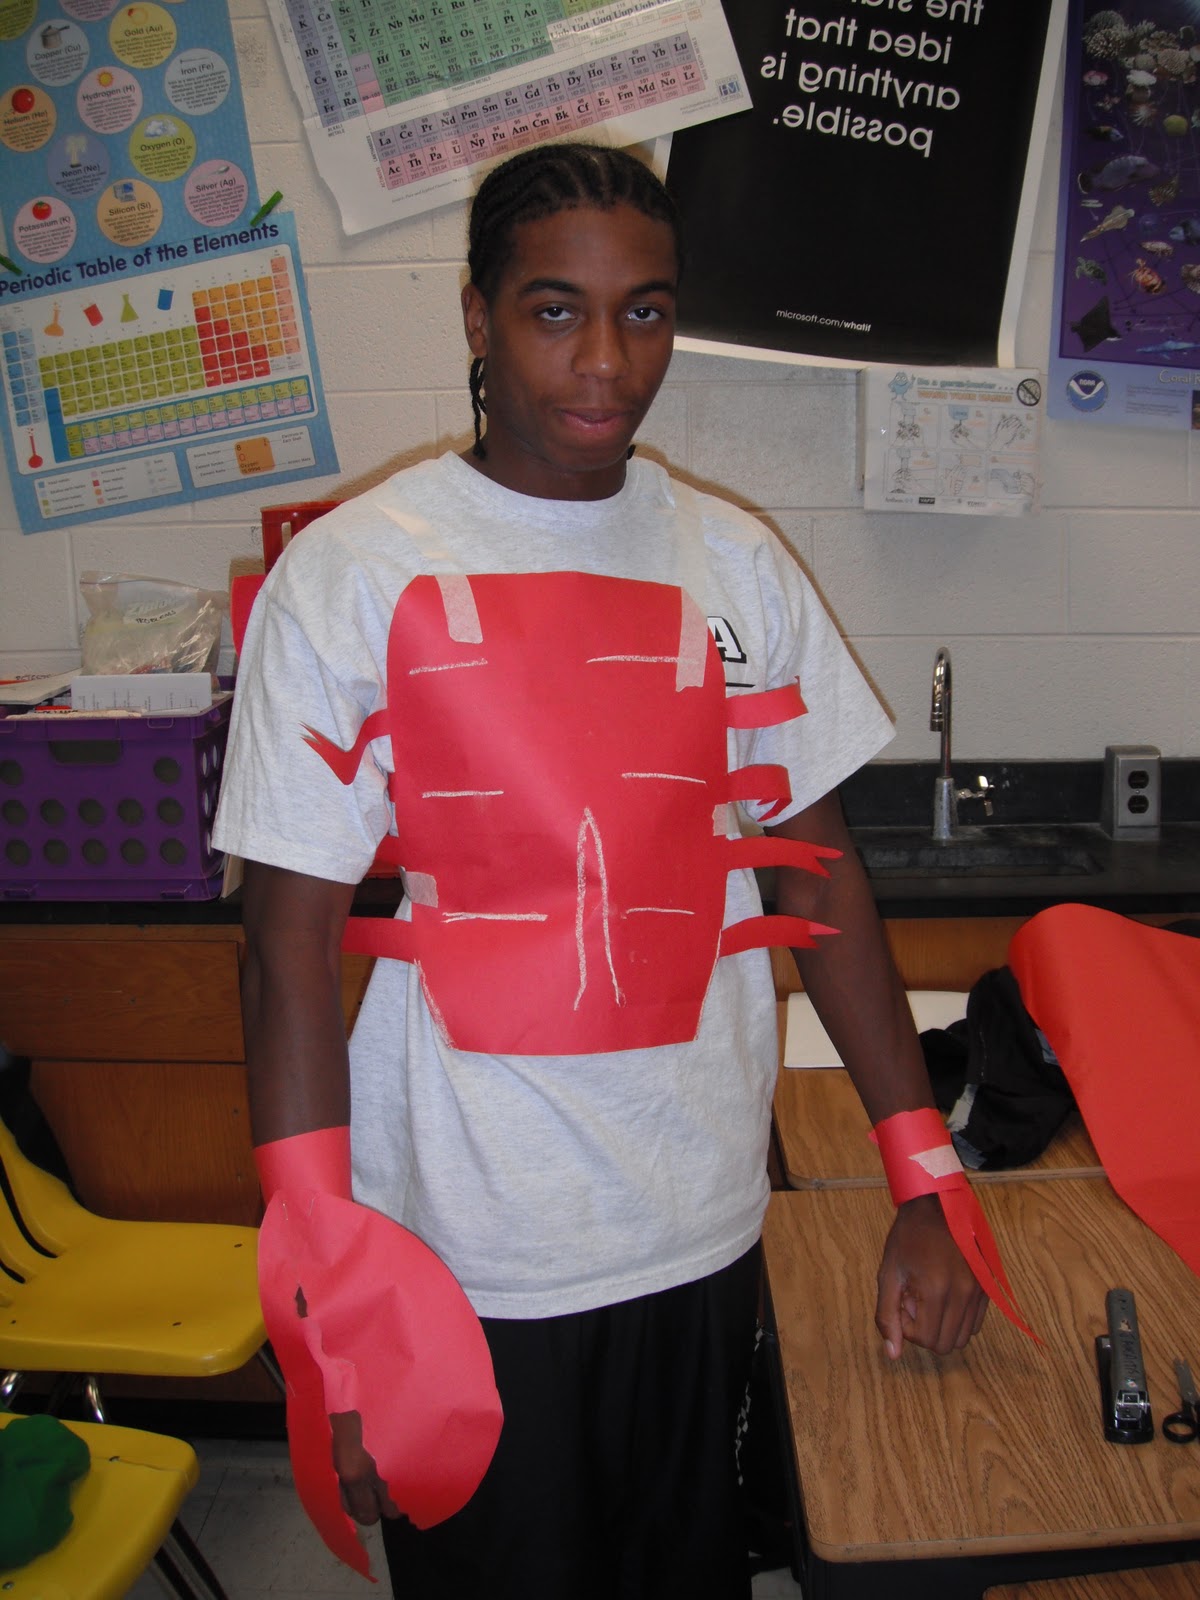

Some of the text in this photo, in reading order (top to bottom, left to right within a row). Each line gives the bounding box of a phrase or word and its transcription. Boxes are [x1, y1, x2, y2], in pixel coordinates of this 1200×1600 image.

[338, 6, 351, 15] Sc
[451, 1, 465, 10] Ru
[430, 7, 444, 16] Tc
[524, 9, 537, 18] Au
[317, 13, 331, 22] Ca
[408, 14, 425, 24] Mo
[503, 15, 515, 24] Pt
[388, 20, 403, 30] Nb
[483, 22, 492, 31] Ir
[124, 25, 163, 37] Gold (Au)
[368, 28, 380, 37] Zr
[460, 29, 474, 38] Os
[349, 34, 357, 42] Y
[438, 36, 453, 45] Re
[327, 41, 339, 50] Sr
[419, 41, 430, 51] W
[674, 43, 687, 51] Lu
[34, 44, 81, 60] Copper (Cu)
[304, 48, 319, 57] Rb
[399, 48, 411, 57] Ta
[652, 48, 666, 58] Yb
[376, 54, 389, 64] Hf
[629, 55, 646, 65] Tm
[181, 62, 214, 75] Iron (Fe)
[610, 62, 622, 71] Er
[334, 69, 348, 78] Ba
[587, 69, 603, 78] Ho
[683, 71, 695, 81] Lr
[314, 77, 327, 85] Cs
[567, 76, 582, 87] Dy
[660, 77, 676, 88] No
[83, 84, 136, 101] Hydrogen (H)
[546, 83, 560, 92] Tb
[638, 82, 656, 94] Md
[525, 89, 540, 99] Gd
[617, 91, 633, 101] Fm
[343, 97, 357, 106] Ra
[504, 97, 518, 106] Eu
[598, 98, 610, 106] Es
[323, 104, 335, 113] Fr
[482, 104, 498, 113] Sm
[577, 102, 590, 113] Cf
[4, 115, 30, 125] Helium
[461, 111, 477, 120] Pm
[555, 110, 569, 121] Bk
[440, 116, 456, 127] Nd
[532, 118, 550, 128] Cm
[421, 124, 433, 133] Pr
[511, 125, 529, 135] Am
[400, 131, 413, 140] Ce
[492, 132, 505, 142] Pu
[140, 138, 185, 152] Oxygen (O)
[379, 138, 391, 147] La
[470, 138, 485, 149] Np
[452, 146, 461, 154] U
[429, 152, 442, 161] Pa
[408, 158, 422, 168] Th
[62, 163, 100, 178] Neon (Ne)
[388, 166, 401, 175] Ac
[195, 178, 236, 192] Silver (Ag)
[108, 201, 152, 216] Silicon (Si)
[18, 216, 71, 233] Potassium (K)
[0, 224, 279, 297] Periodic Table of the Elements
[776, 310, 872, 332] microsoft.com/whatif
[1159, 369, 1191, 384] Coral
